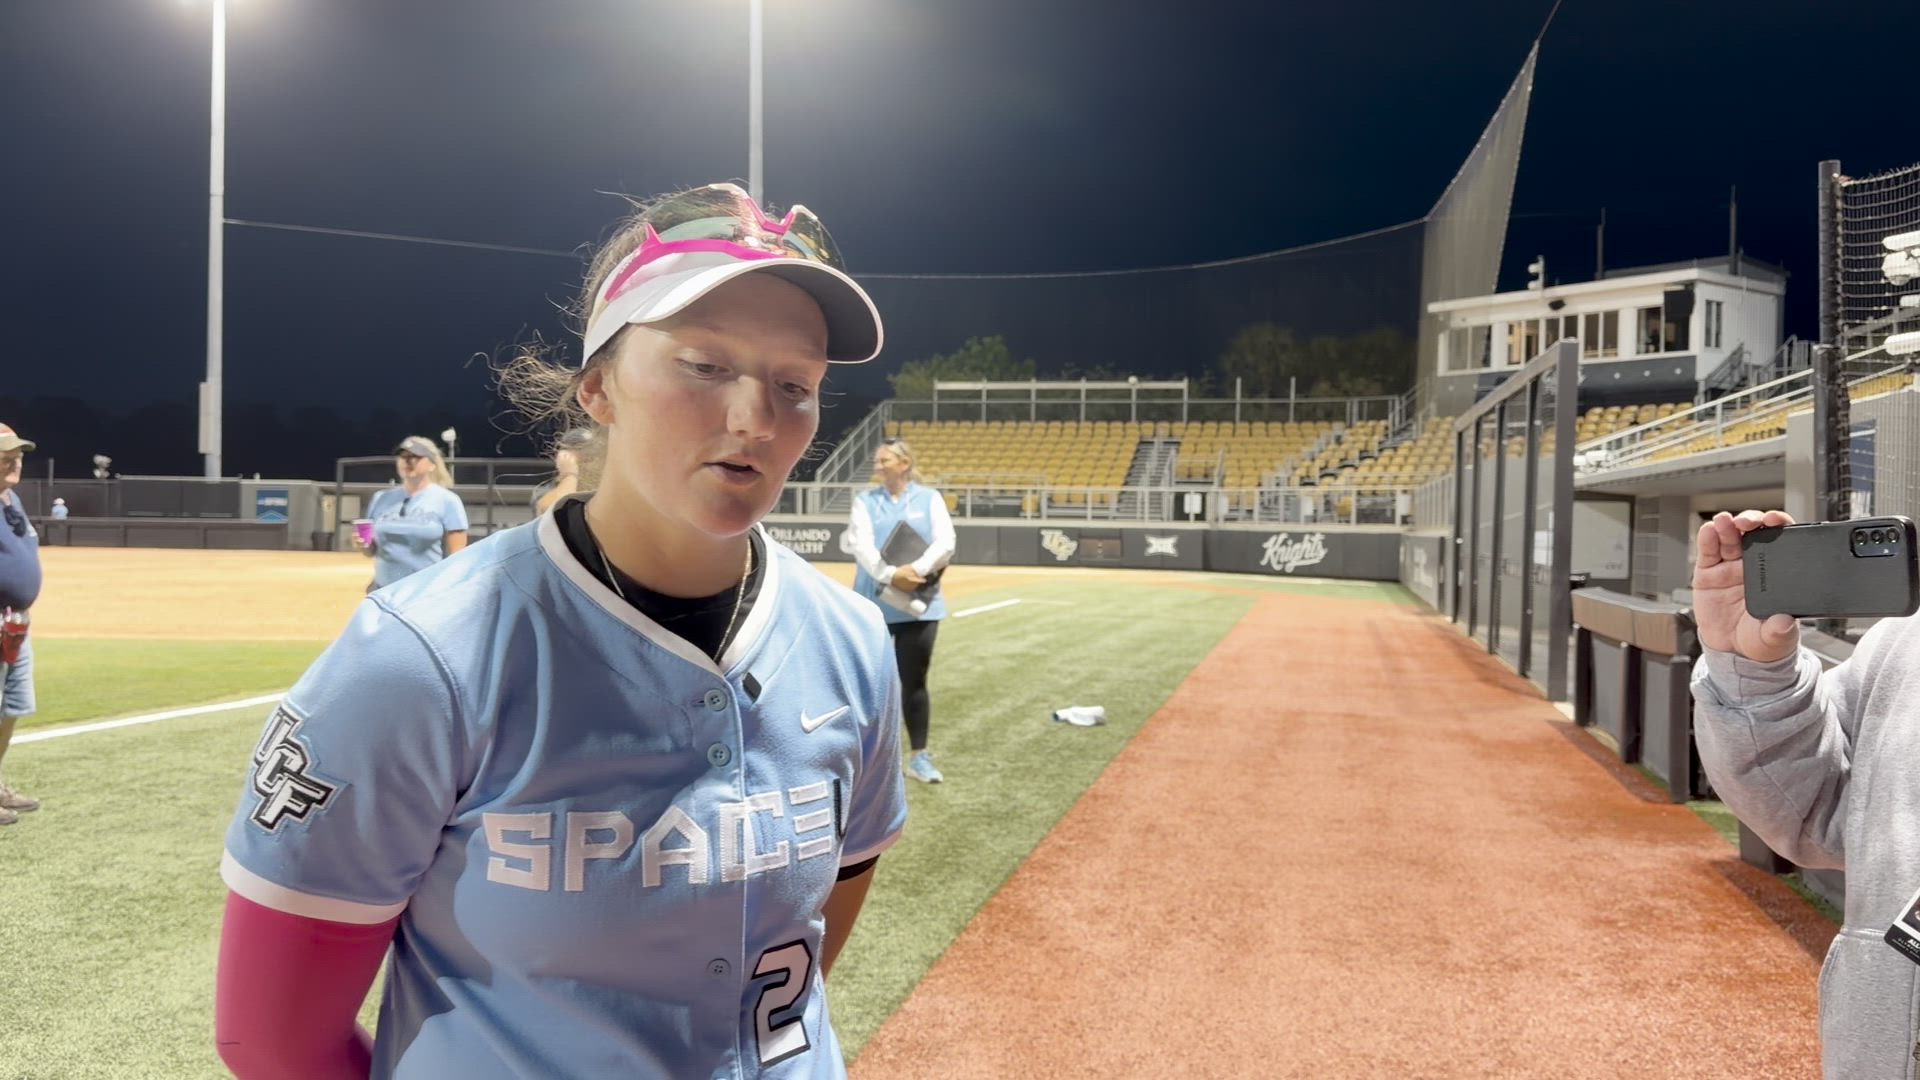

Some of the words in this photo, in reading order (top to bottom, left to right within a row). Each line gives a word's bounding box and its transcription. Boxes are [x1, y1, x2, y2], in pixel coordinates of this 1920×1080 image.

[768, 527, 831, 541] ORLANDO
[1260, 533, 1328, 573] Knights
[250, 702, 337, 832] UCF
[482, 781, 833, 892] SPACE
[751, 938, 813, 1070] 2
